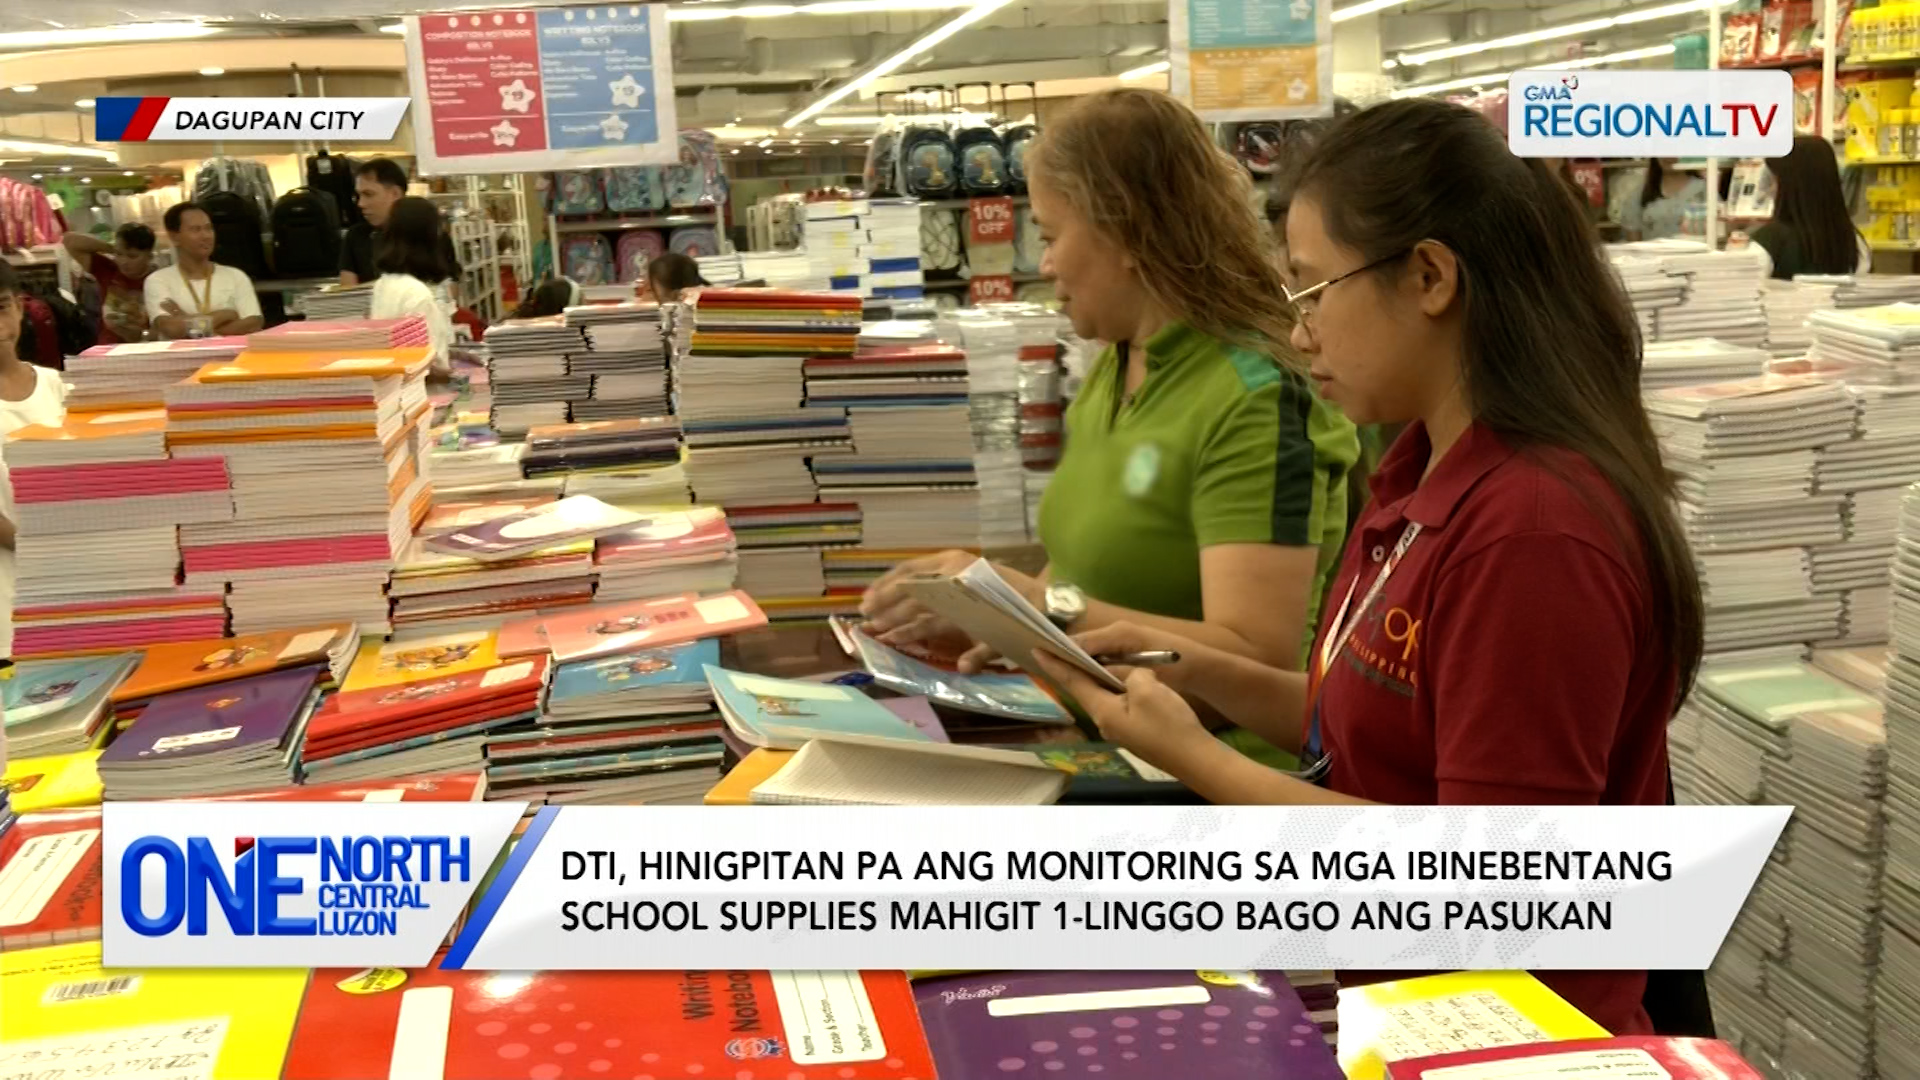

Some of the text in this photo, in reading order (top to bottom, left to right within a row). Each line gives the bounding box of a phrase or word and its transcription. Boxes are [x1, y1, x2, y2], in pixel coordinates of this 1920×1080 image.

[973, 204, 1012, 220] 10%
[978, 221, 1006, 235] OFF
[973, 280, 1012, 297] 10%
